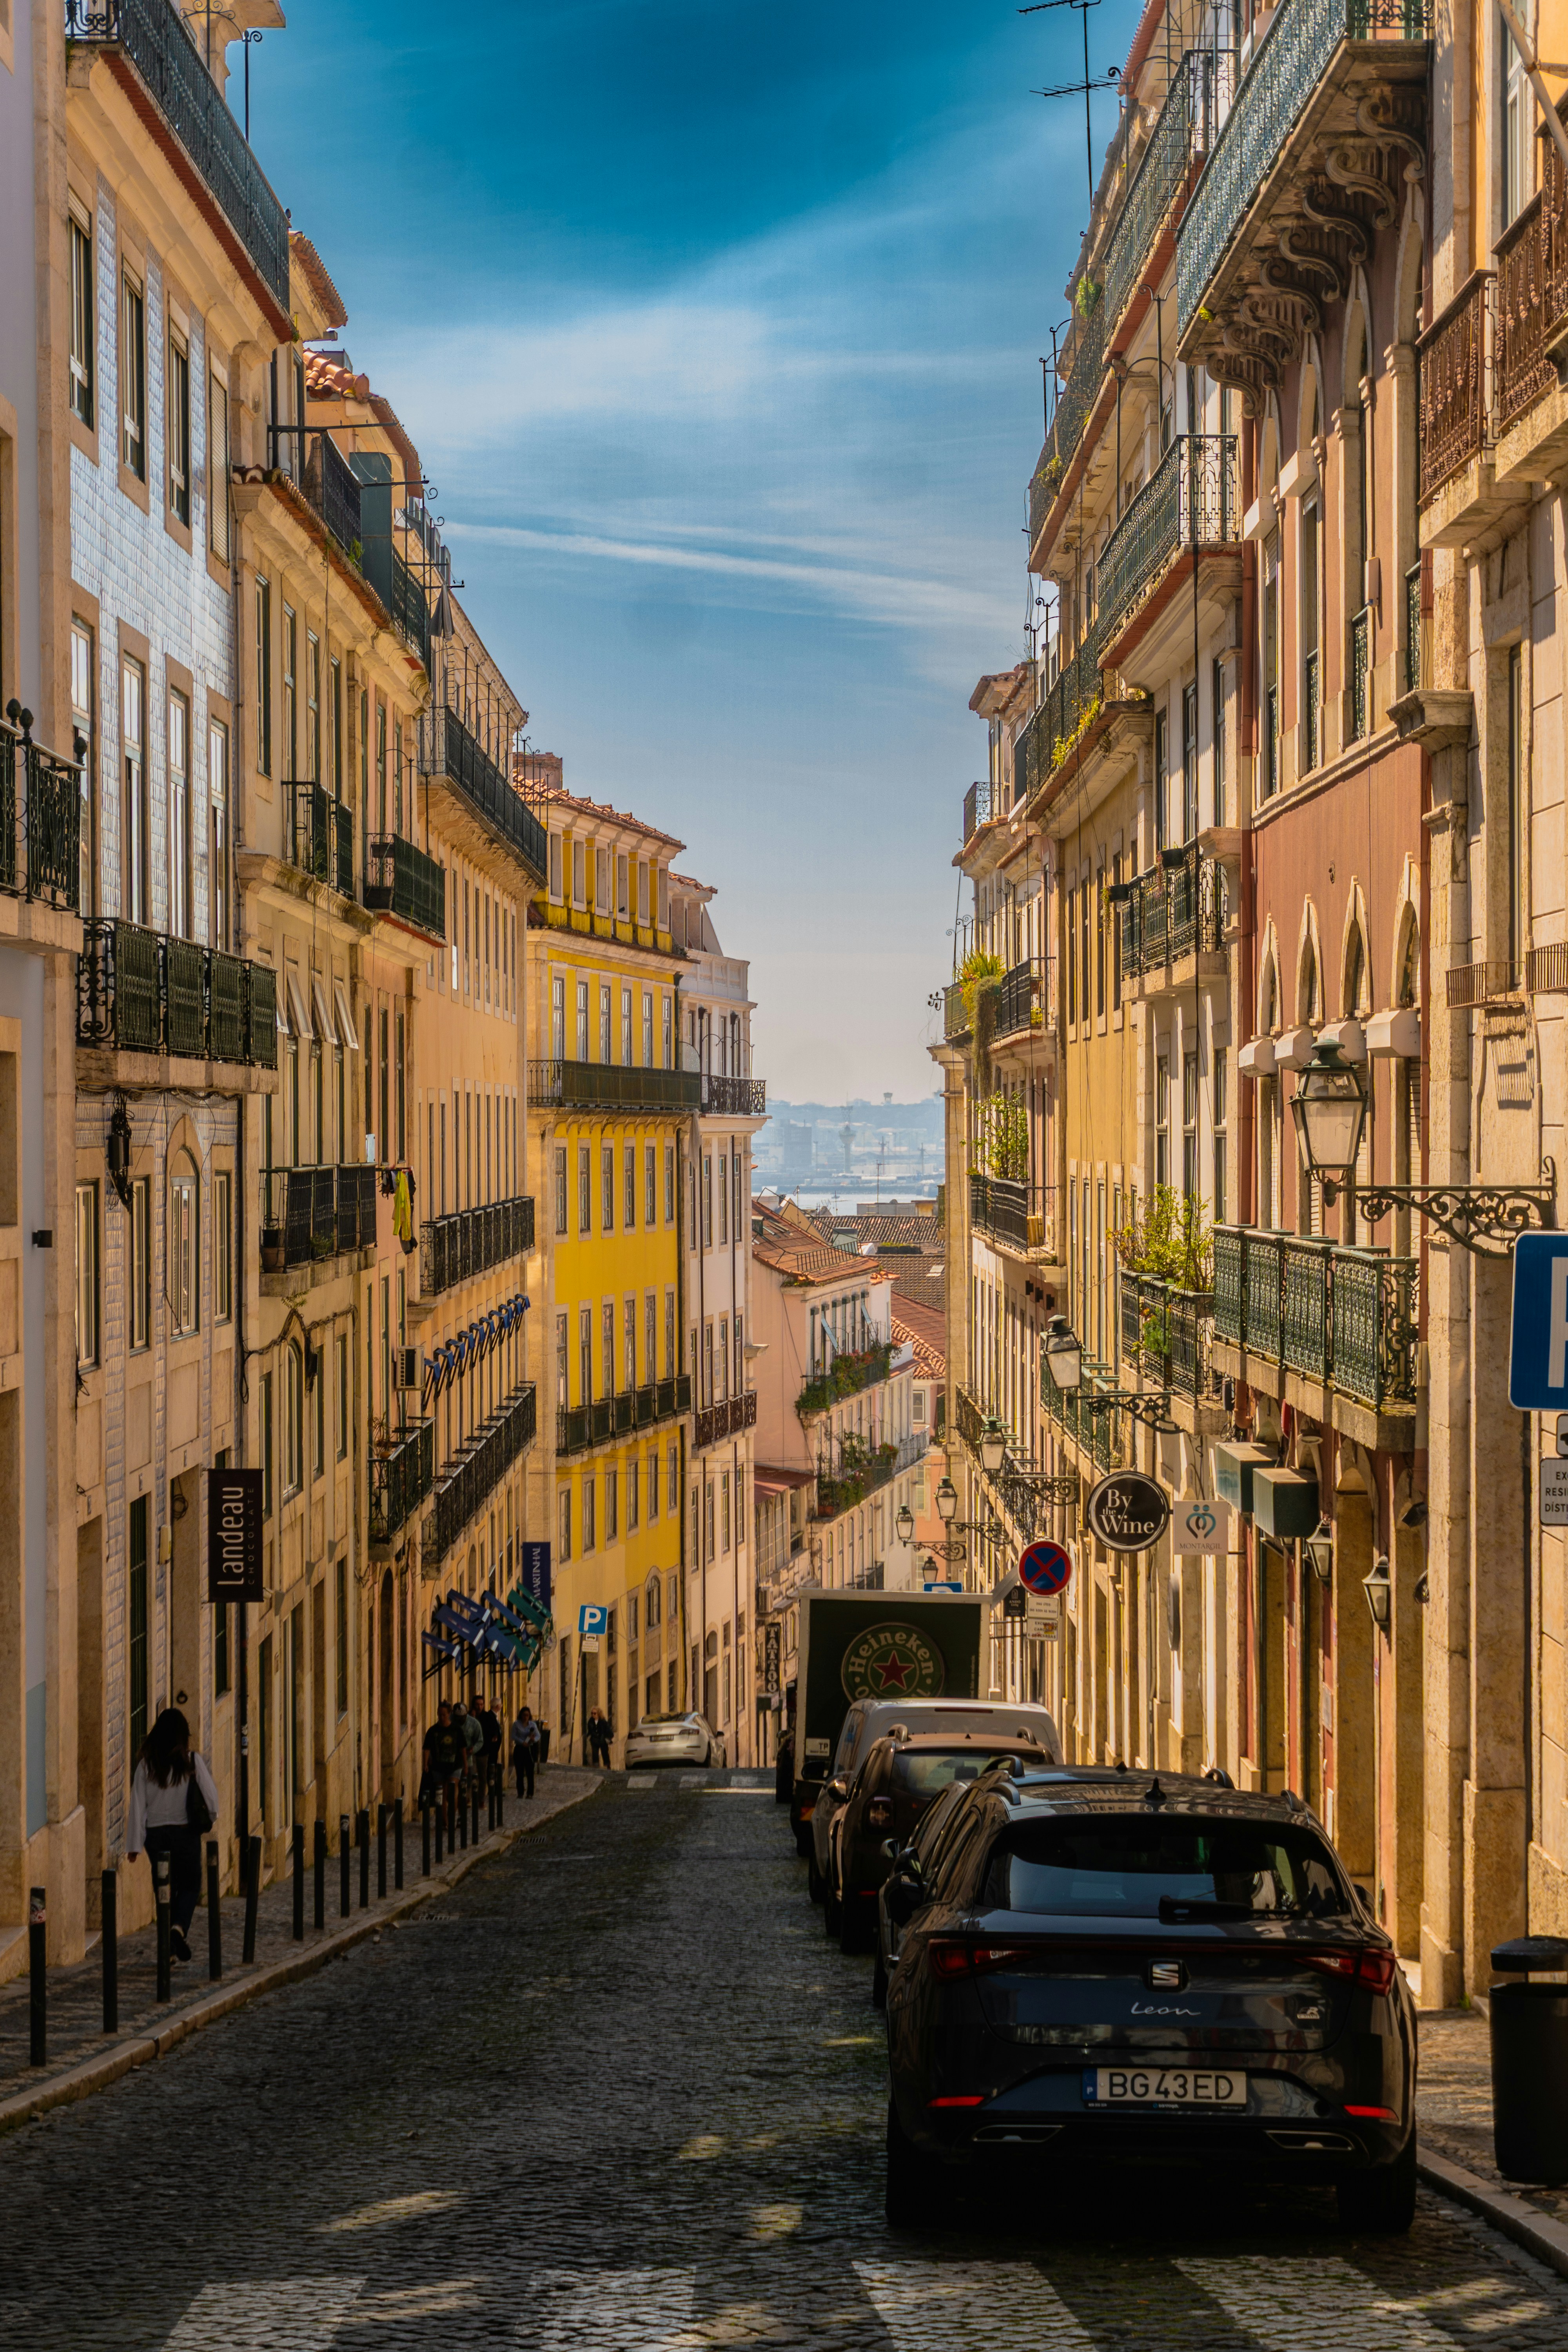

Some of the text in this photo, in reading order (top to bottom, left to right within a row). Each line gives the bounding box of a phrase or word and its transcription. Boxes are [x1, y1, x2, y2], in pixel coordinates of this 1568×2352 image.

[1556, 1472, 1568, 1480] EX
[1106, 1489, 1132, 1518] By
[1546, 1488, 1568, 1496] RESI
[217, 1487, 244, 1584] landeau
[1100, 1515, 1154, 1534] Wine
[532, 1546, 541, 1598] MARTINHAL
[584, 1607, 601, 1631] P
[767, 1627, 778, 1692] TATTOO
[848, 1632, 934, 1675] Heineken
[818, 1742, 828, 1751] TP
[1131, 2002, 1201, 2015] Leon
